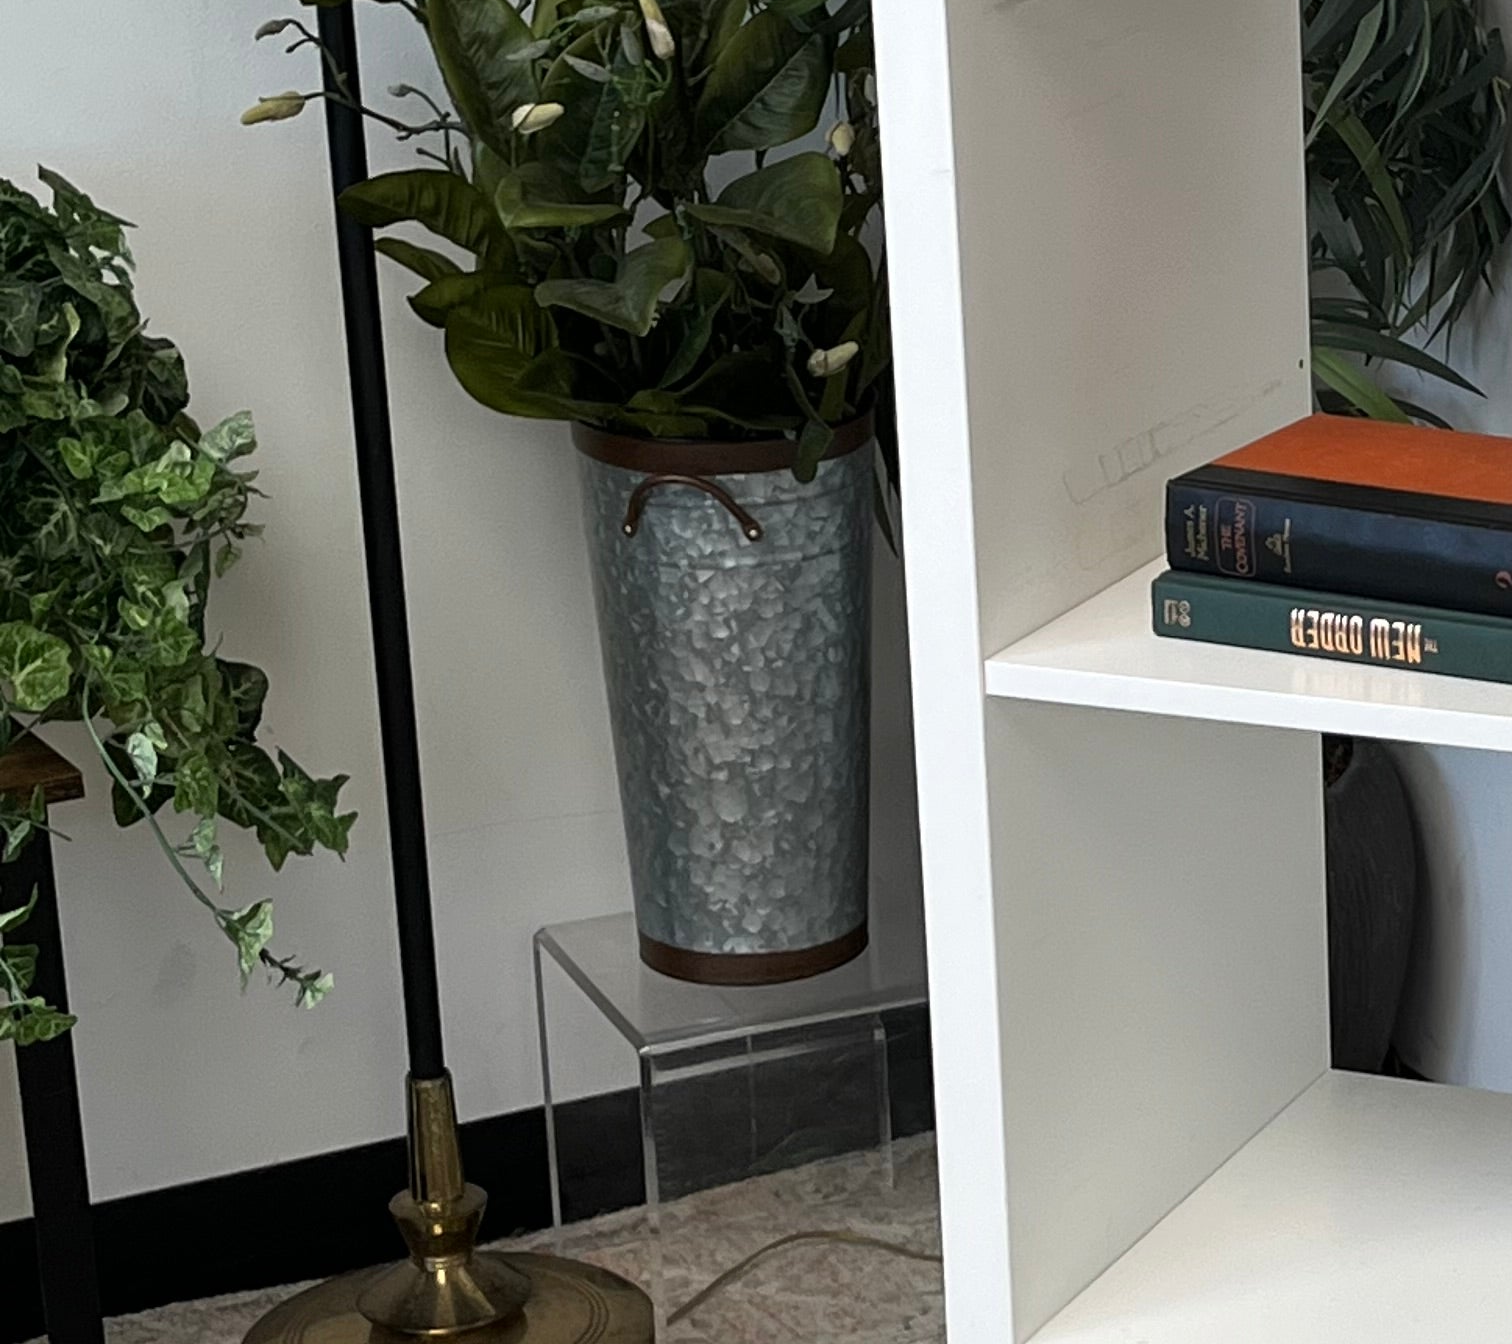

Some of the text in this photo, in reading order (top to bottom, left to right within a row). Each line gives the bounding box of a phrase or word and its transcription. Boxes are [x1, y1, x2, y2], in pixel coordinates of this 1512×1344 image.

[1220, 524, 1232, 551] THE
[1234, 501, 1248, 573] COVENANT
[1290, 607, 1438, 663] THE NEW ORDER
